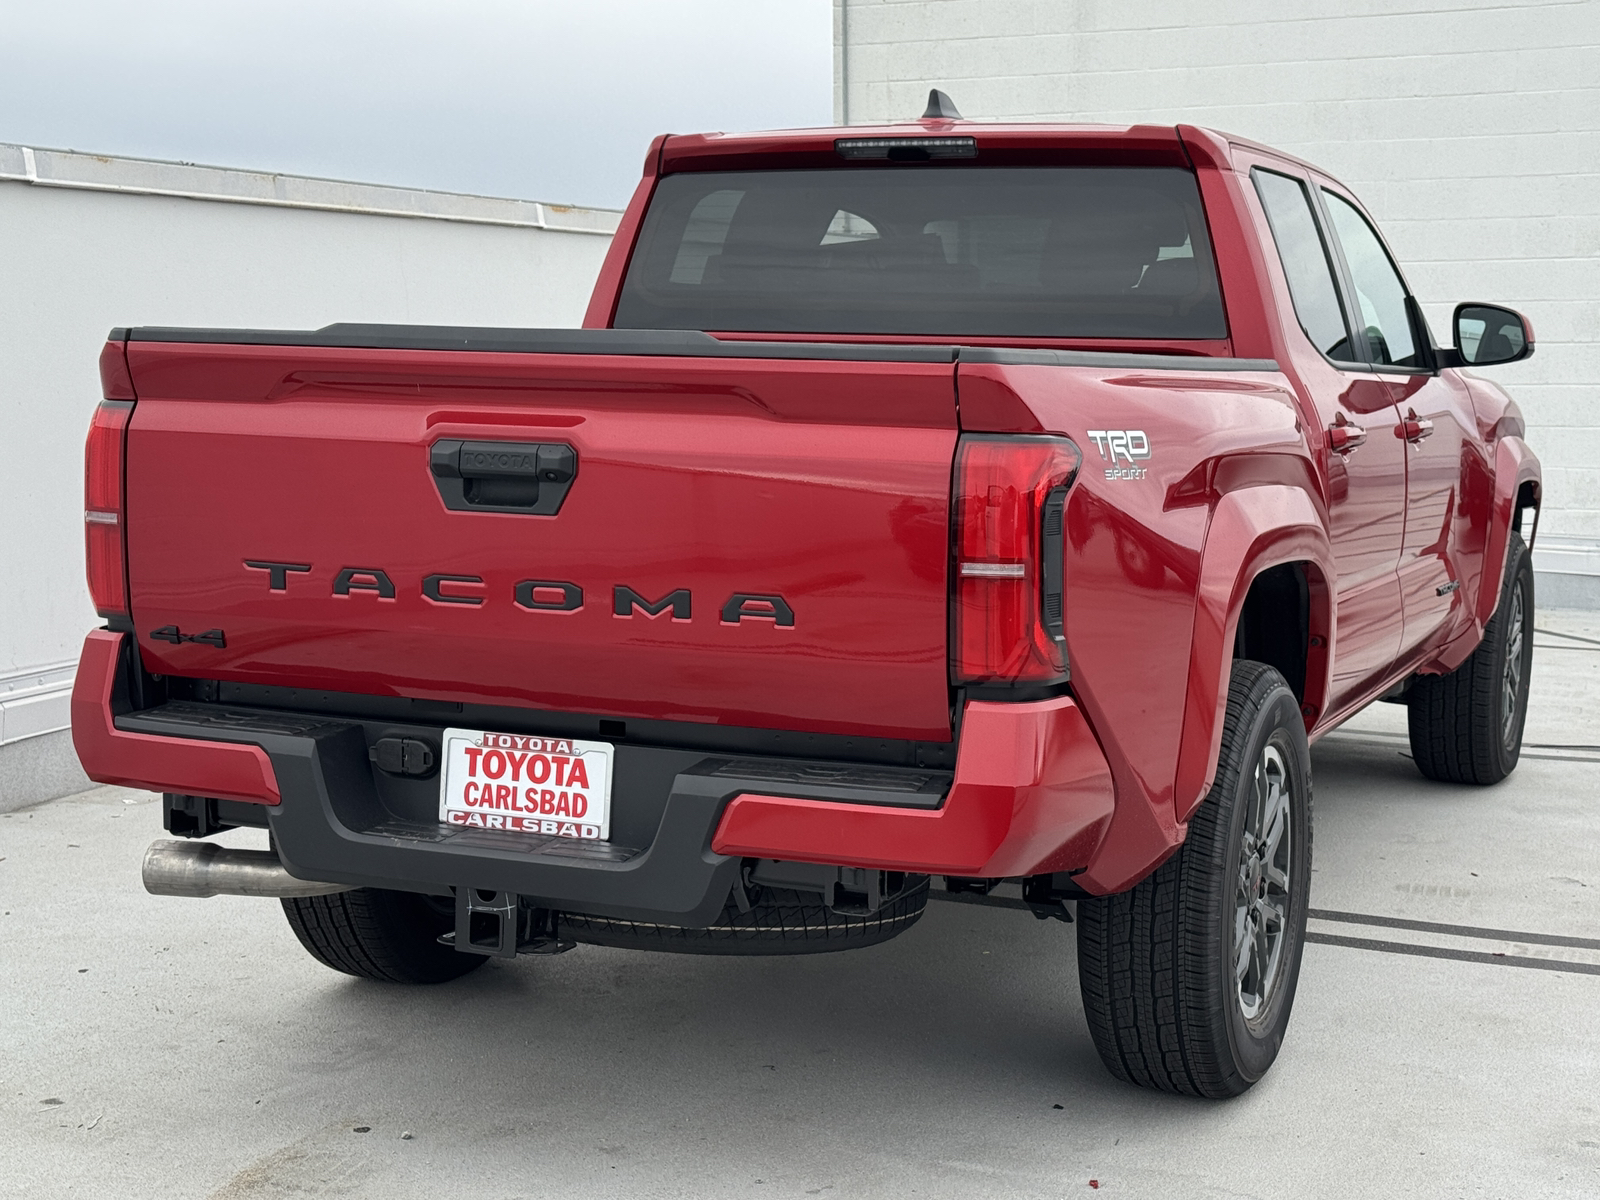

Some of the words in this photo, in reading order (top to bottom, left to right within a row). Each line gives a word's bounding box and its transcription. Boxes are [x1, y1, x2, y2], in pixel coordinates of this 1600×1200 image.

[463, 452, 533, 470] TOYOTA
[1086, 430, 1151, 464] TRD
[1104, 468, 1148, 480] SPORT
[243, 560, 795, 629] TACOMA
[485, 733, 571, 754] TOYOTA
[465, 747, 590, 789] TOYOTA
[463, 781, 588, 818] CARLSBAD
[447, 811, 599, 839] CARLSBAD
